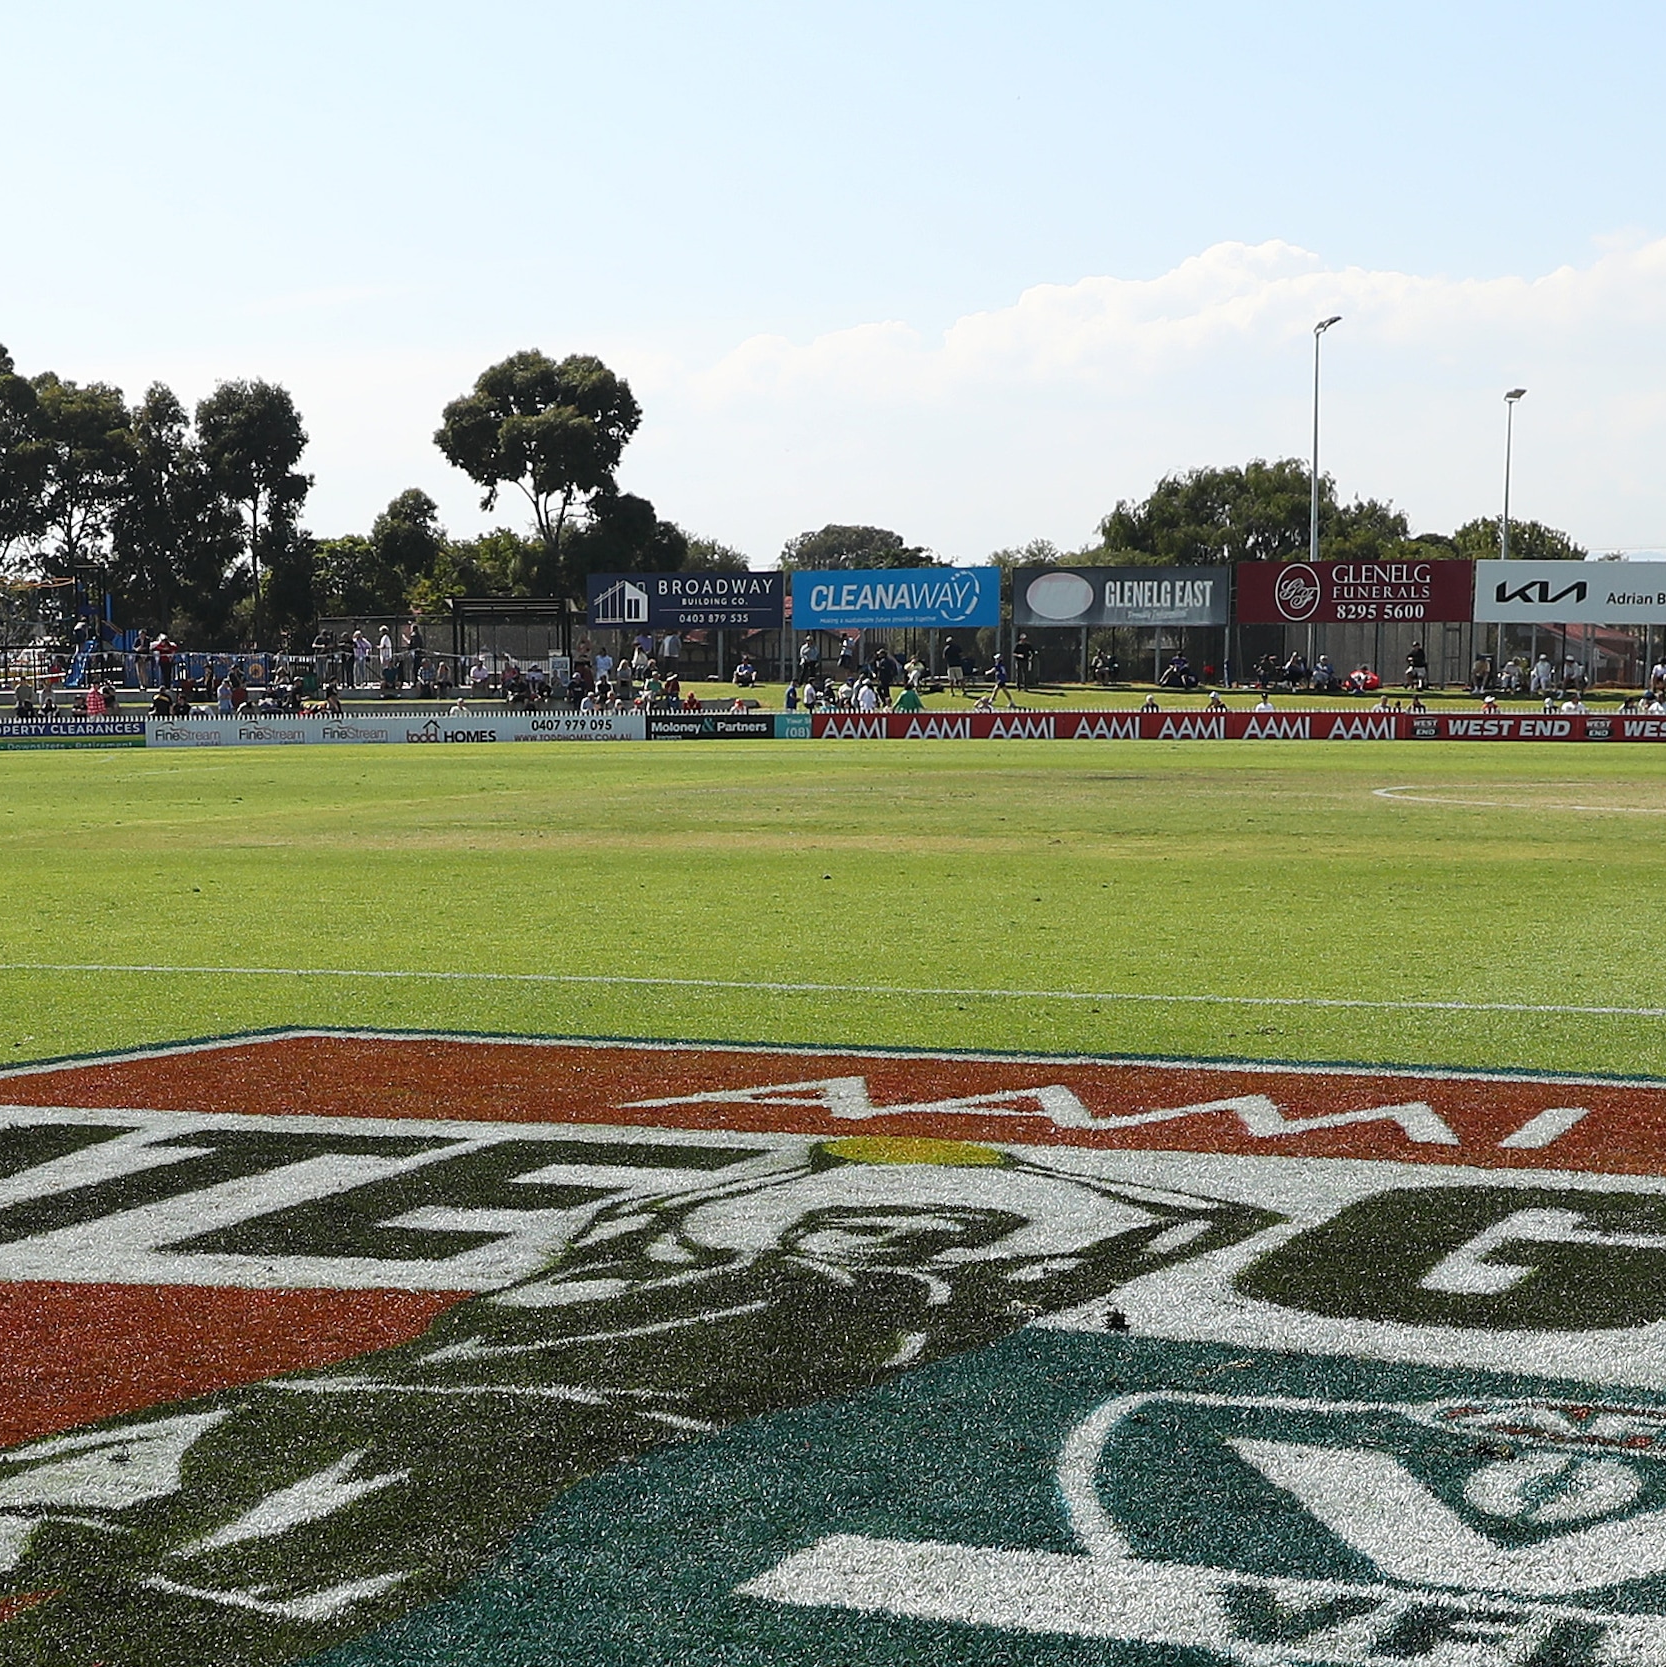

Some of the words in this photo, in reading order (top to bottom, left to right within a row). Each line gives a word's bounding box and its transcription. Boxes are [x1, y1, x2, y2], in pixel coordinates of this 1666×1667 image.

[1331, 564, 1431, 584] GLENELG
[658, 579, 774, 595] BROADWAY
[1104, 581, 1171, 608] GLENELG
[1175, 580, 1214, 608] EAST
[1332, 586, 1430, 598] FUNERALS
[681, 597, 728, 606] BUILDING
[731, 597, 749, 605] CO.
[810, 582, 971, 612] CLEANAWAY
[1606, 592, 1653, 605] Adrian
[679, 614, 705, 624] 0403
[708, 614, 726, 623] 879
[729, 613, 749, 622] 535
[1336, 604, 1377, 619] 8295
[1383, 604, 1425, 618] 5600
[50, 723, 141, 734] CLEARANCES
[531, 720, 561, 731] 0407
[565, 720, 586, 731] 979
[589, 719, 612, 730] 095
[651, 722, 702, 734] Moloney
[702, 718, 715, 732] &
[717, 722, 767, 732] Partners
[821, 717, 889, 739] AAMI
[904, 717, 971, 739] AAMI
[988, 716, 1056, 739] AAMI
[1072, 716, 1141, 740] AAMI
[1157, 716, 1226, 740] AAMI
[1241, 716, 1311, 740] AAMI
[1327, 716, 1396, 740] AAMI
[1412, 718, 1439, 726] WEST
[1447, 719, 1515, 736] WEST
[1518, 719, 1571, 737] END
[1586, 718, 1612, 727] WEST
[155, 728, 221, 742] FineStream
[239, 727, 305, 741] FineStream
[322, 726, 388, 741] FineStream
[406, 728, 440, 743] todd
[443, 730, 496, 743] HOMES
[785, 727, 811, 739] (08)
[1415, 728, 1436, 736] END
[1588, 729, 1610, 738] END
[620, 1074, 1590, 1150] AAMI
